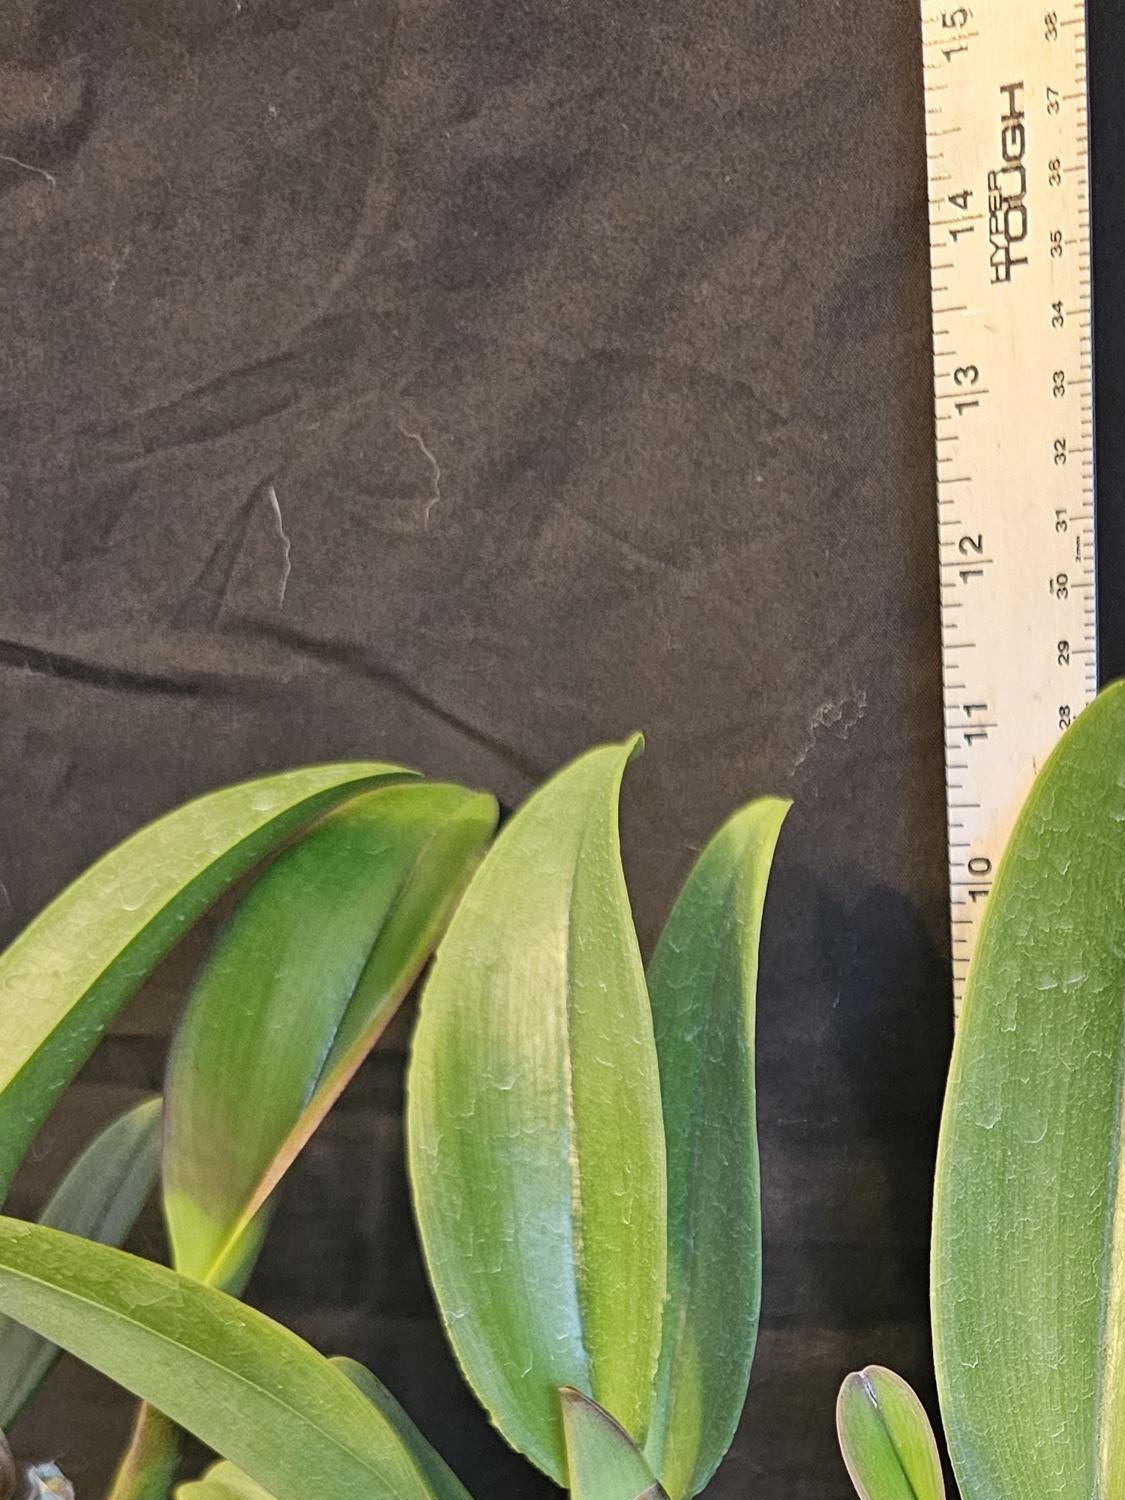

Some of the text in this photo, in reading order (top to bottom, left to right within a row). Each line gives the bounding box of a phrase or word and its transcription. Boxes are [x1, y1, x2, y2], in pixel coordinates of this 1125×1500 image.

[941, 8, 969, 62] 15
[1045, 11, 1058, 42] 38
[1047, 87, 1060, 115] 37
[1000, 81, 1028, 282] TOUGH
[1049, 158, 1062, 187] 36
[948, 189, 974, 242] 14
[987, 170, 1010, 285] HYPER
[1051, 230, 1063, 258] 35
[1052, 300, 1064, 328] 34
[954, 364, 979, 415] 13
[1053, 370, 1065, 397] 33
[1054, 438, 1067, 465] 32
[1055, 508, 1068, 533] 31
[959, 533, 984, 584] 12
[1056, 573, 1070, 600] 30
[1057, 640, 1070, 666] 29
[963, 703, 988, 746] 11
[1058, 705, 1071, 729] 28
[968, 857, 992, 903] 10
